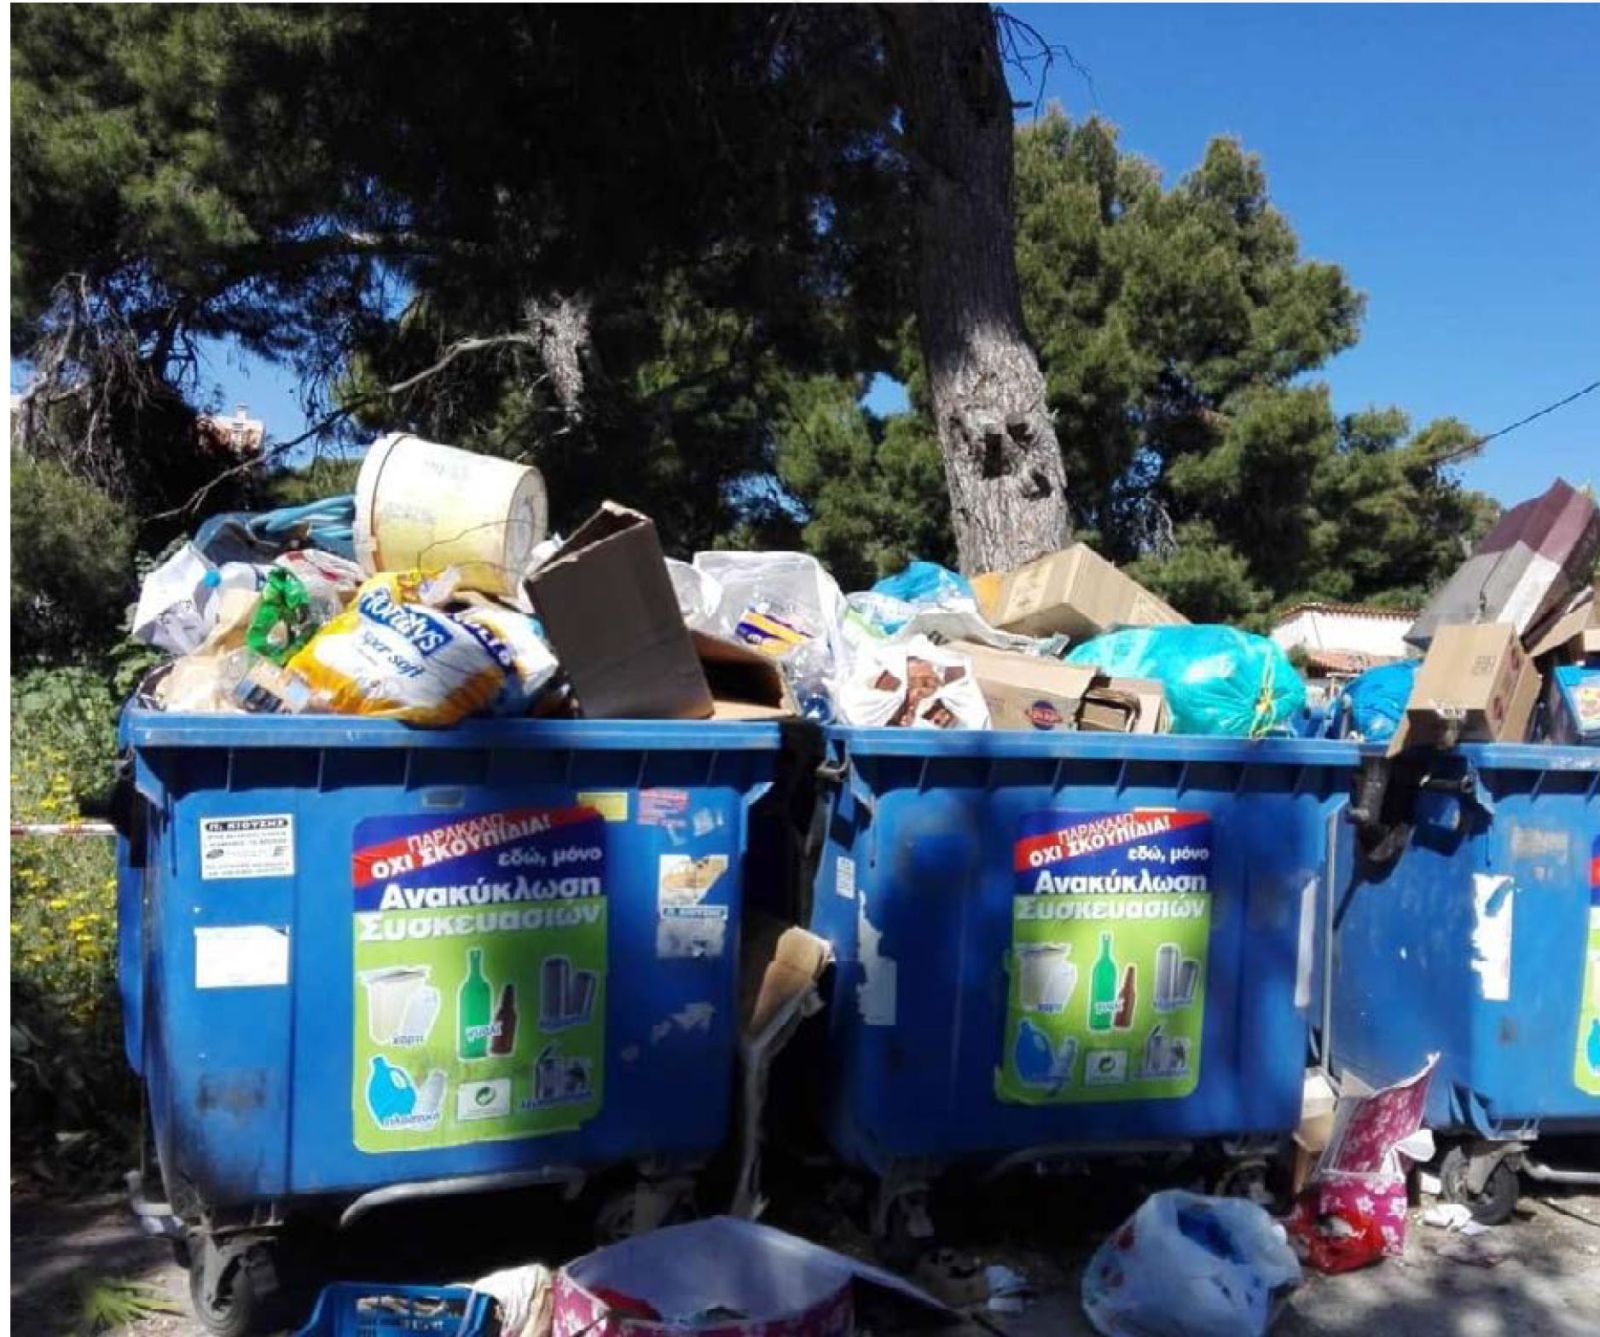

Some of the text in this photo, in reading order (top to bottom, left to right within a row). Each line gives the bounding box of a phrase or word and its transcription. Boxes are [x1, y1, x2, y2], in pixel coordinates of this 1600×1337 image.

[371, 813, 551, 879] ΟΧΙ ΣΚΟΥΠΙΔΙΑ!
[1029, 815, 1171, 867] ΟΧΙ ΣΚΟΥΠΙΔΙΑ!
[1170, 846, 1209, 863] μόνο
[553, 846, 602, 867] μόνο
[379, 875, 601, 909] Ανακύκλωση
[1035, 868, 1207, 893] Ανακύκλωση
[360, 899, 600, 941] Συσκευασιών
[1016, 894, 1205, 919] Συσκευασιών
